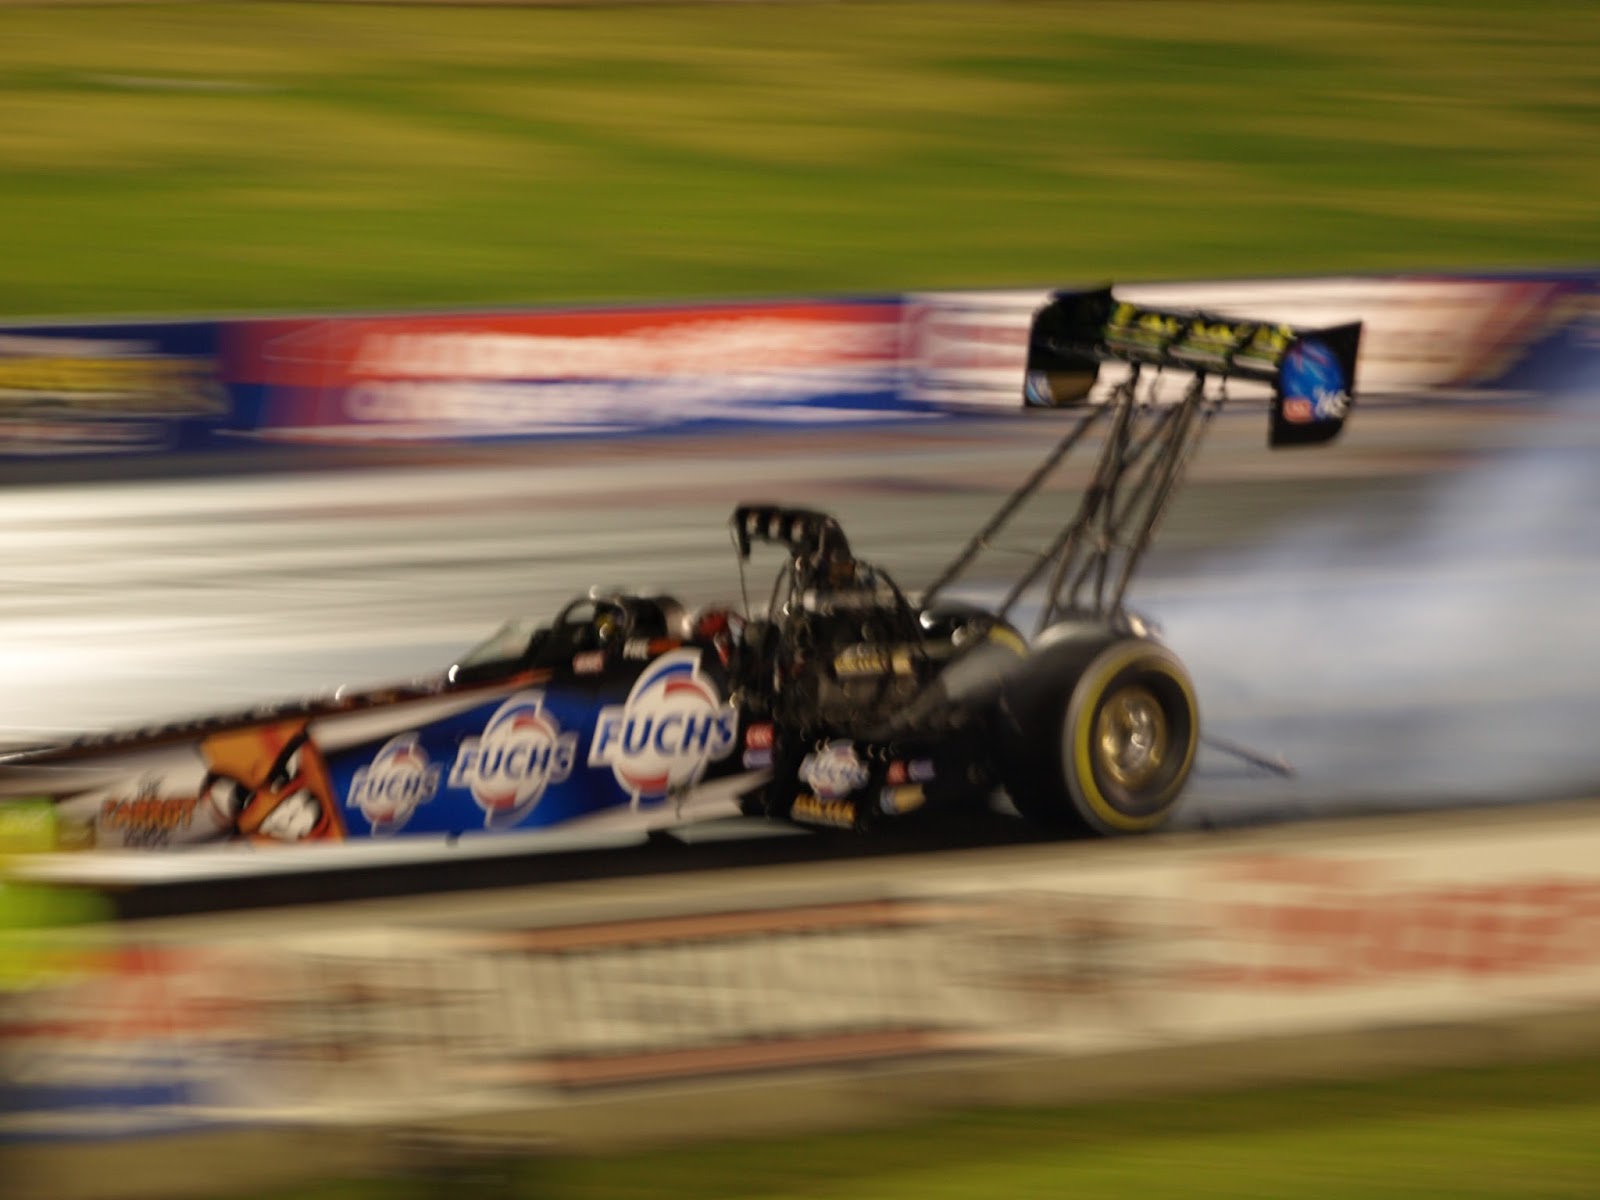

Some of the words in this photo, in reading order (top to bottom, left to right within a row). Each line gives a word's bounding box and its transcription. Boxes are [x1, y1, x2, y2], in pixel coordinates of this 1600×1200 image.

[597, 711, 734, 755] FUCHS
[457, 743, 575, 783] FUCHS
[352, 770, 436, 799] FUCHS
